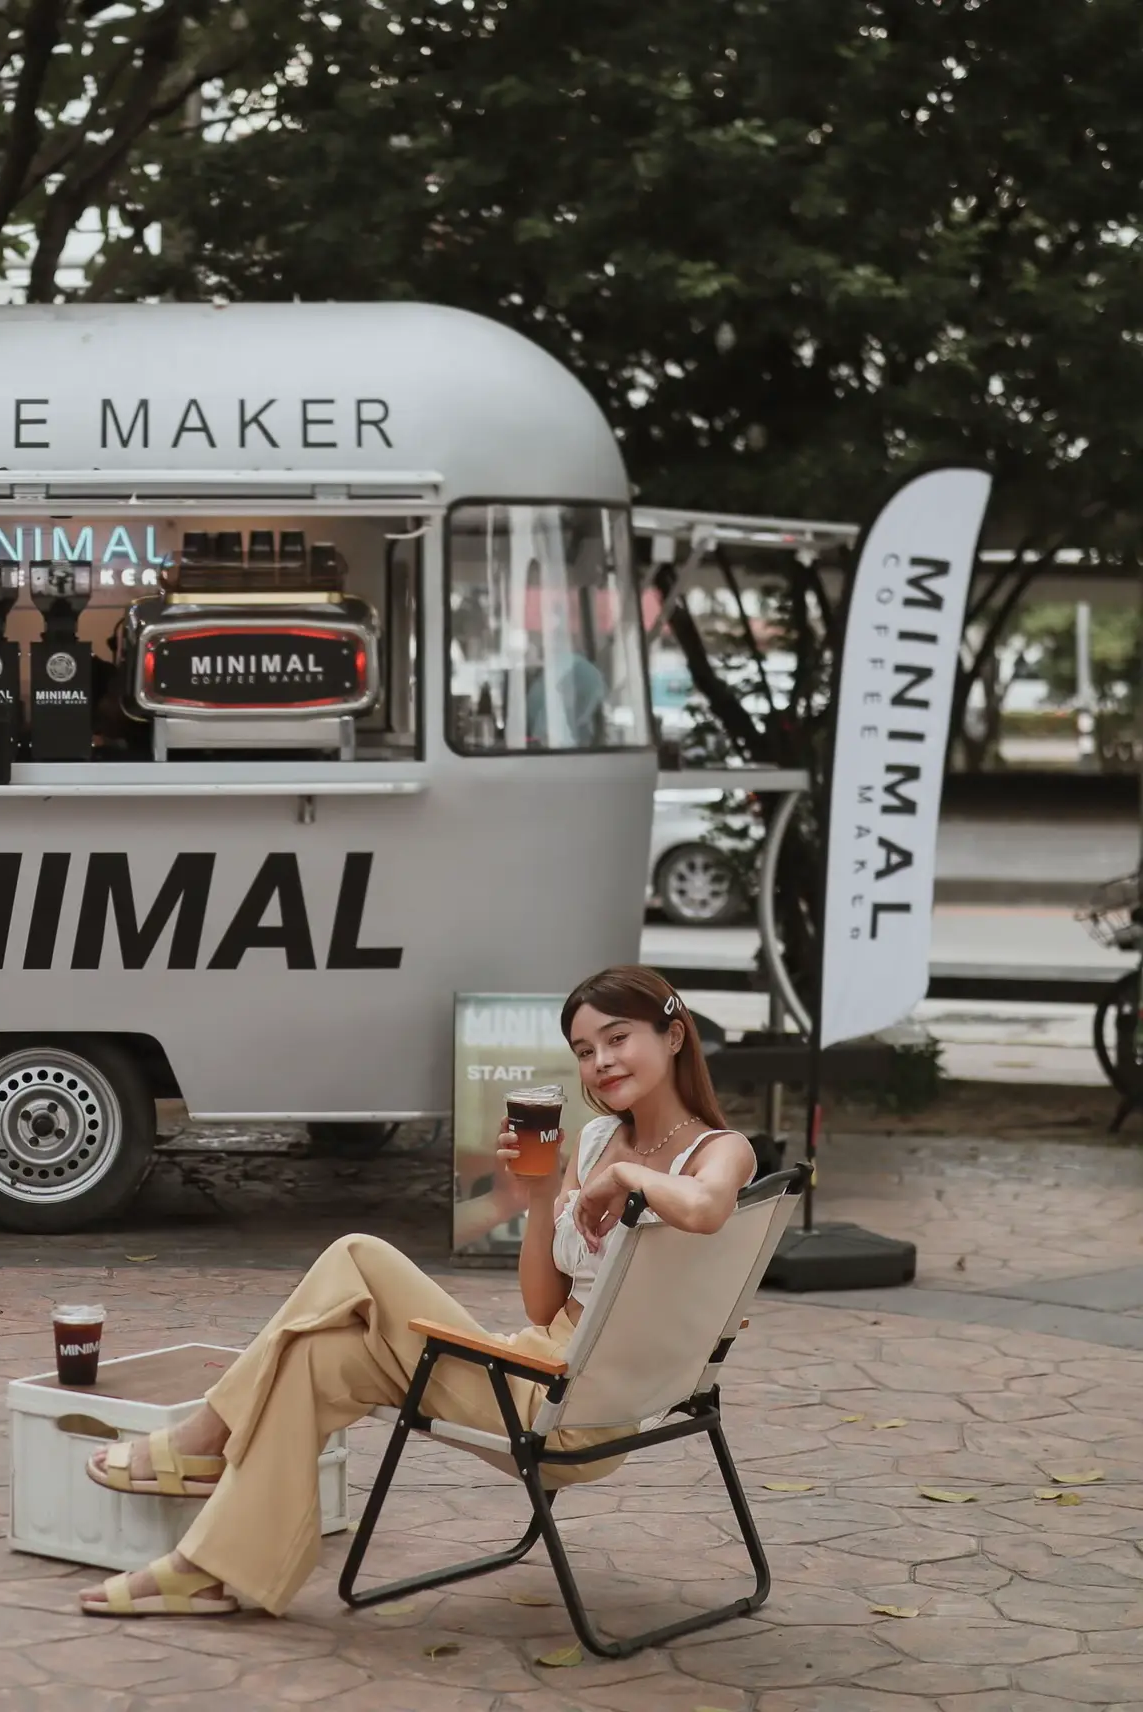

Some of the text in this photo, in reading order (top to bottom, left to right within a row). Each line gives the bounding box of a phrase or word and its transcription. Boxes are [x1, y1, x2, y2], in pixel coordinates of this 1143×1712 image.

[100, 399, 394, 449] MAKER
[860, 552, 901, 740] COFFEE
[191, 654, 324, 675] MINIMAL
[191, 674, 324, 685] COFFEE MAKER
[35, 690, 88, 700] MINIMAL
[869, 556, 951, 941] MINIMAL
[467, 1065, 535, 1081] START
